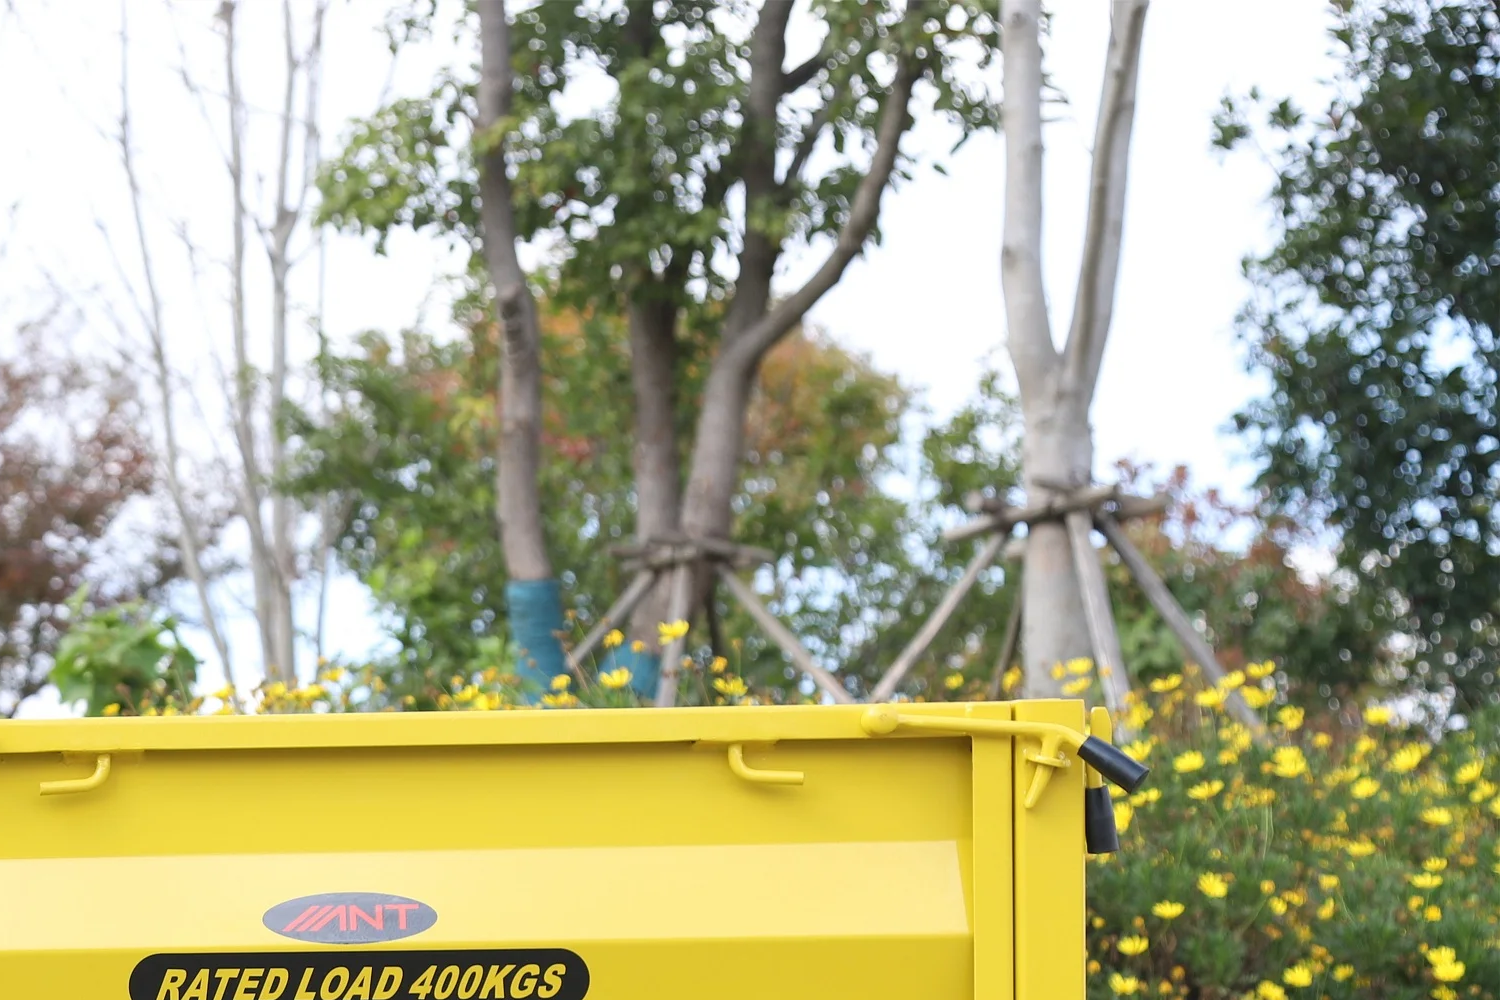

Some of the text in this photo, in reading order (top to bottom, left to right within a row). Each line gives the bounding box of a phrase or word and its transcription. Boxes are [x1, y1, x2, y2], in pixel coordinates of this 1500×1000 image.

[283, 904, 419, 932] ANT
[293, 966, 403, 1000] LOAD
[409, 963, 567, 999] 400KGS
